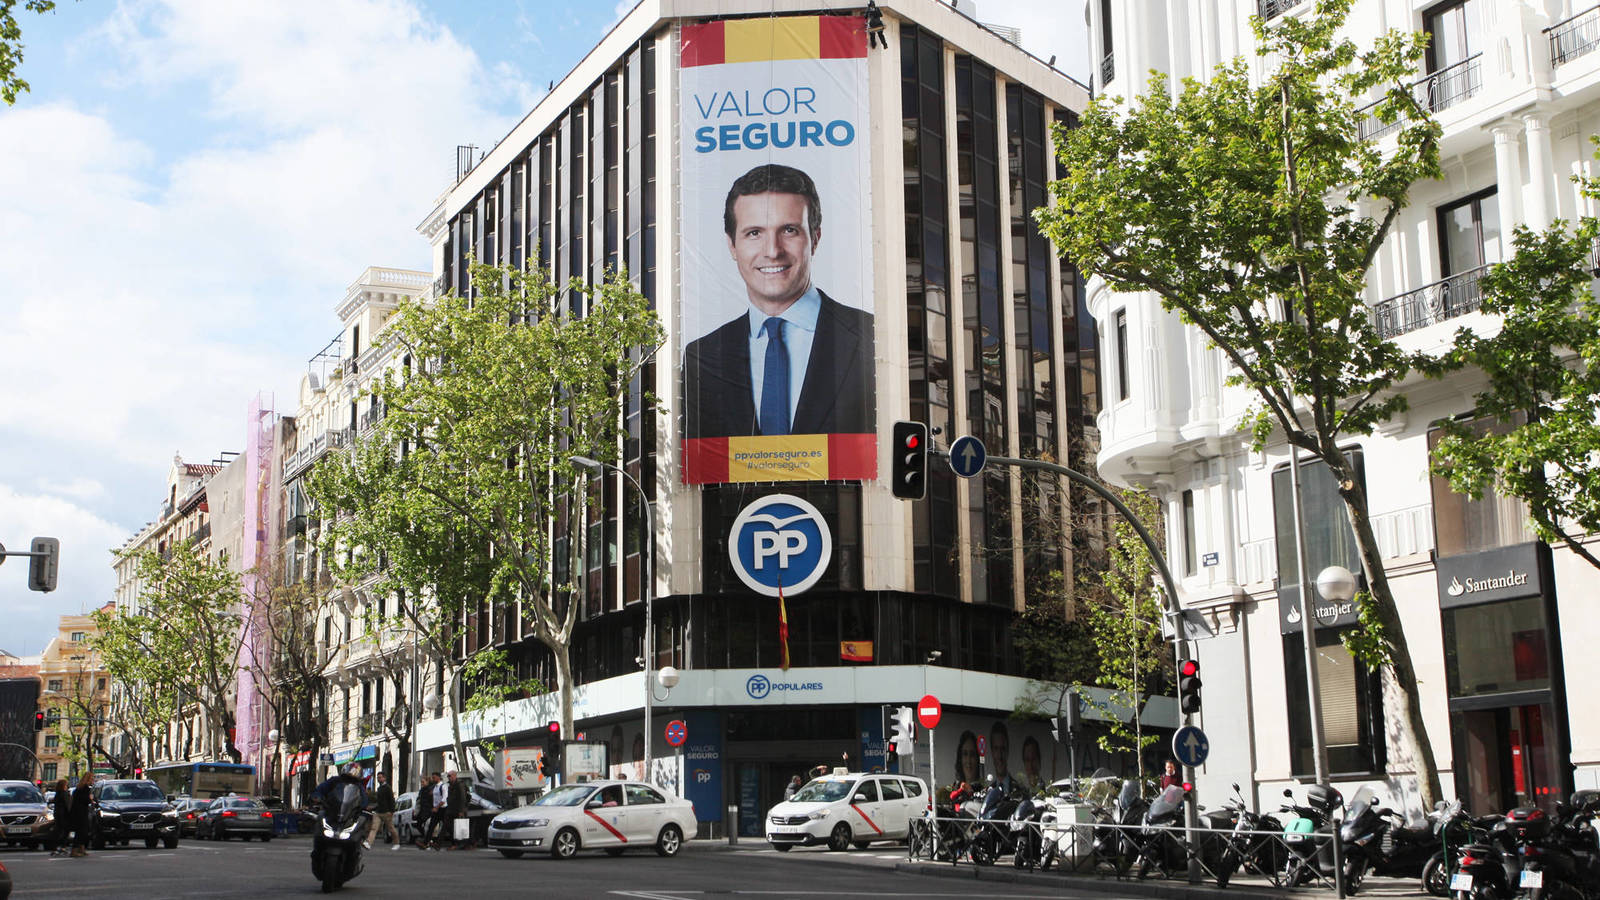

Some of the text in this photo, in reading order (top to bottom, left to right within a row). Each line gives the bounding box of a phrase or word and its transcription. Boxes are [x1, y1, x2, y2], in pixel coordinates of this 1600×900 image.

[694, 87, 816, 119] VALOR
[695, 120, 855, 153] SEGURO
[735, 450, 822, 461] ppvalorseguro.es
[747, 461, 810, 471] #valorseguro
[753, 530, 808, 569] PP
[1465, 569, 1527, 593] Santander
[771, 683, 823, 691] POPULARES
[687, 752, 719, 760] SEGURO
